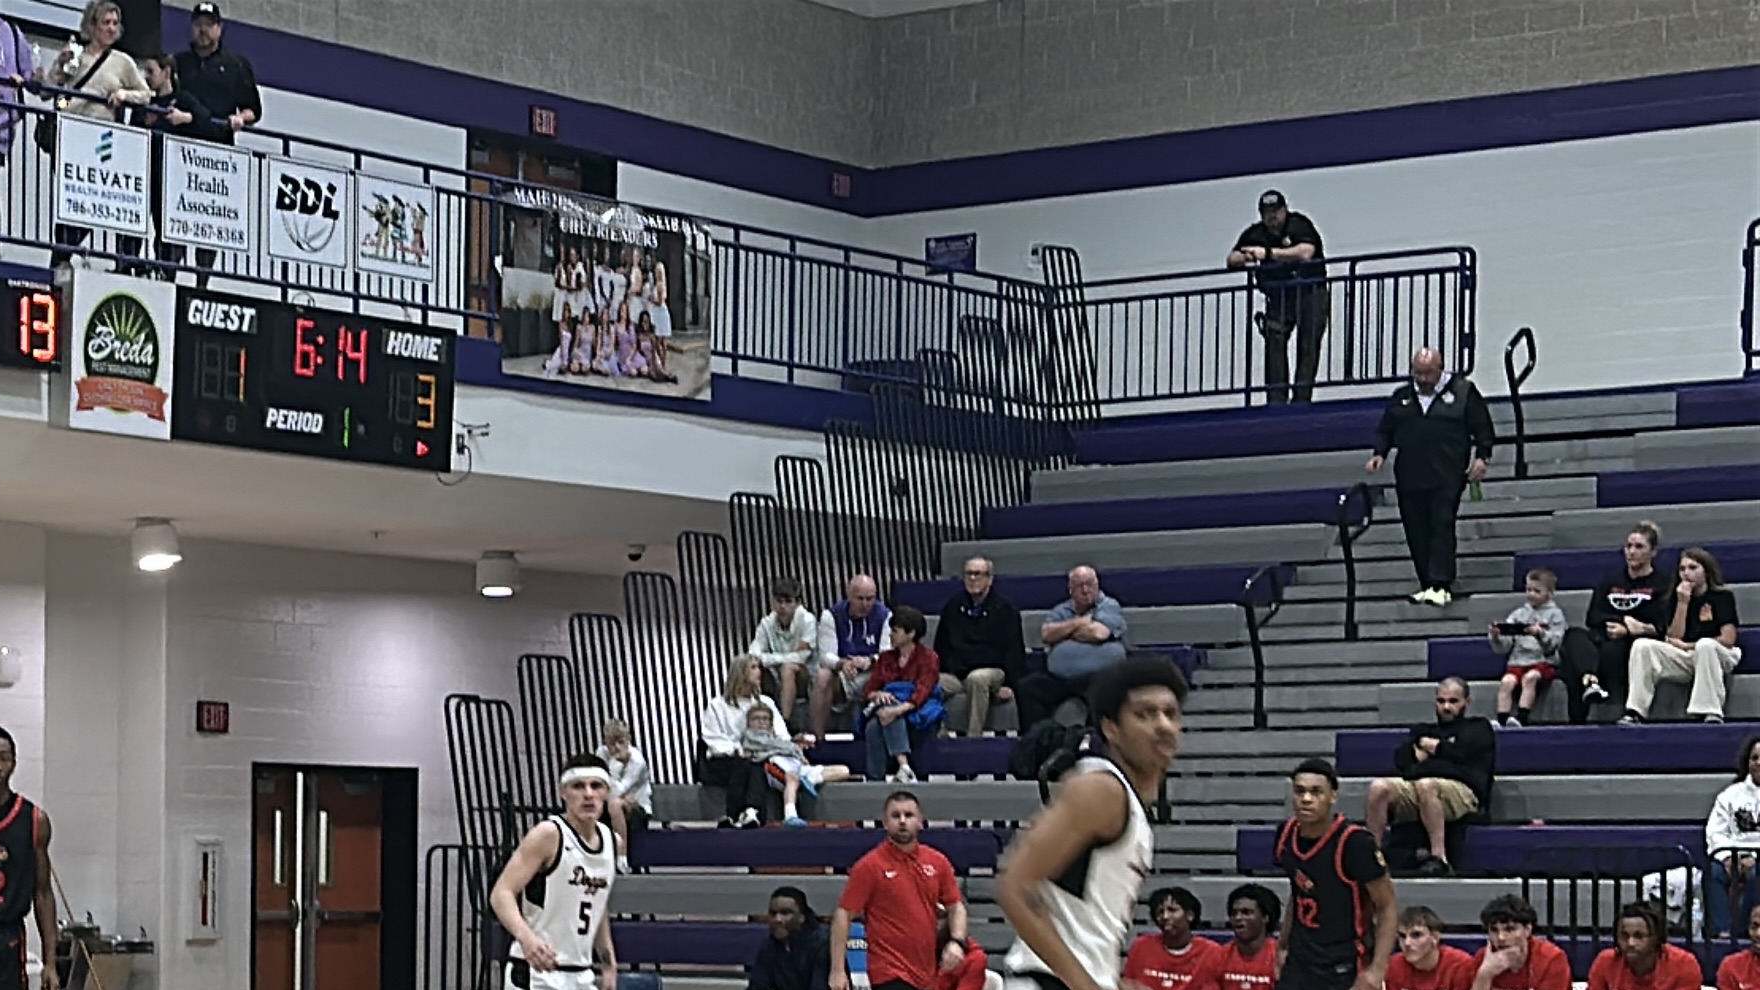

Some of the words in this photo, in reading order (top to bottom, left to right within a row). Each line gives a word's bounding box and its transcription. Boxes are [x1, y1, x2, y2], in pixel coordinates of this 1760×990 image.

[180, 146, 237, 173] Women's
[64, 163, 143, 192] ELEVATE
[188, 172, 229, 196] Health
[67, 199, 140, 224] 706-353-2728
[177, 193, 239, 220] Associates
[170, 218, 245, 244] 770-267-8368
[19, 293, 56, 363] 13
[188, 299, 256, 332] GUEST
[88, 325, 155, 365] Breda
[294, 317, 368, 383] 6:14
[387, 329, 443, 361] HOME
[416, 373, 437, 429] 3
[266, 406, 324, 434] PERIOD
[577, 900, 593, 935] 5
